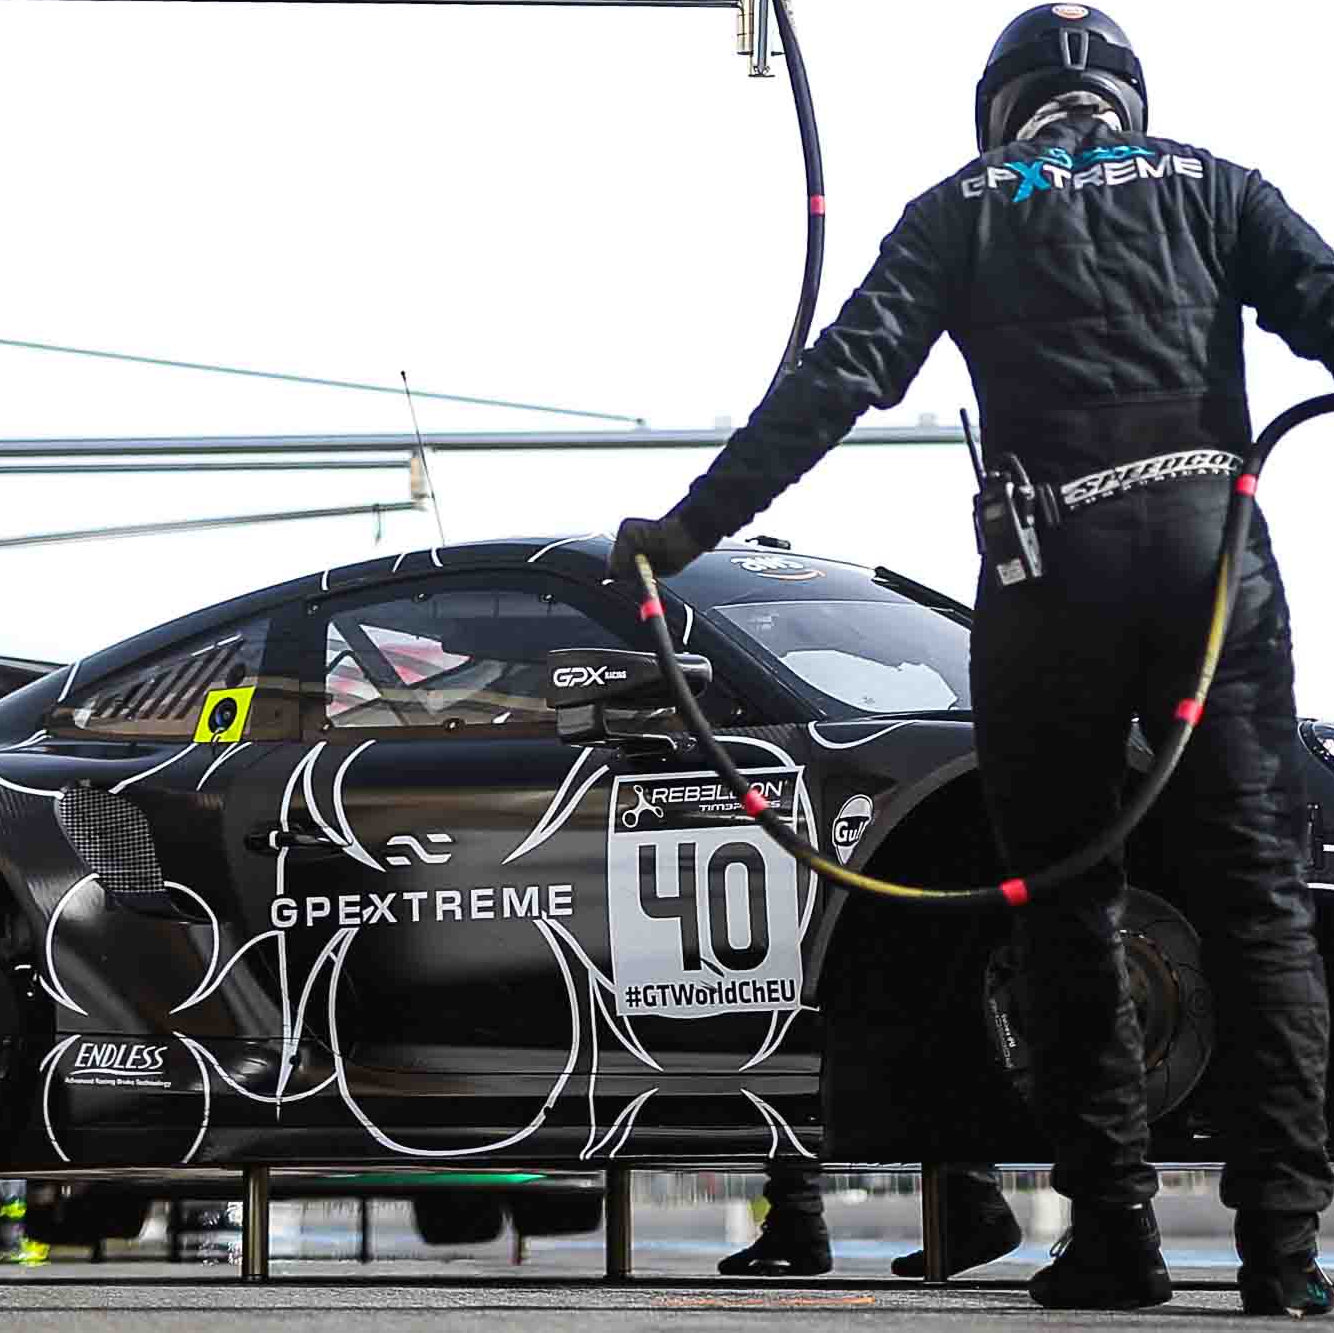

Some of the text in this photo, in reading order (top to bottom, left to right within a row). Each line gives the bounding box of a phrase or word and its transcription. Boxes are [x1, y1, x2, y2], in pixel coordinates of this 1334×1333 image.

[553, 666, 608, 687] GPX
[651, 780, 784, 804] REBELON
[834, 820, 865, 843] Gul
[270, 884, 573, 928] GPEXTREME
[638, 840, 770, 972] 40
[625, 979, 796, 1008] #GTWorldChEU
[75, 1042, 168, 1070] ENDLESS
